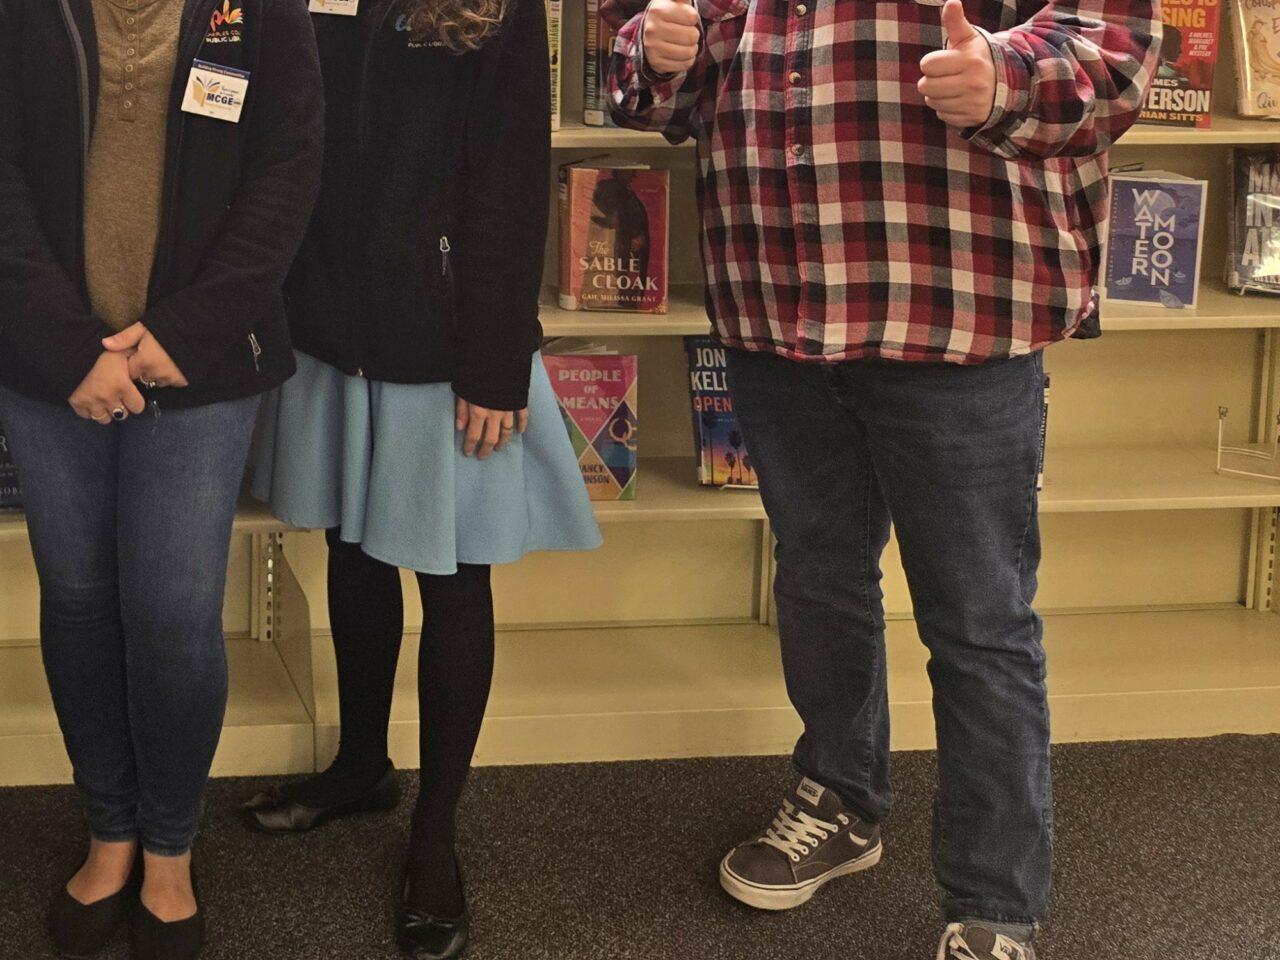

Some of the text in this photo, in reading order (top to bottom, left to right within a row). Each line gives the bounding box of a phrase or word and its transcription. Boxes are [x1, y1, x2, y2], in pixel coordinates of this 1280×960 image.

[586, 60, 596, 74] THE
[206, 92, 234, 106] MCGE
[585, 76, 596, 109] WAITING
[1143, 89, 1210, 113] ERSON
[1169, 113, 1204, 121] SITTS
[1131, 188, 1161, 277] WATER
[588, 240, 610, 254] The
[1150, 214, 1176, 287] MOON
[579, 256, 640, 272] SABLE
[592, 274, 658, 291] CLOAK
[695, 347, 727, 368] JON
[559, 369, 622, 382] PEOPLE
[562, 396, 619, 410] MEANS
[693, 396, 733, 412] OPEN
